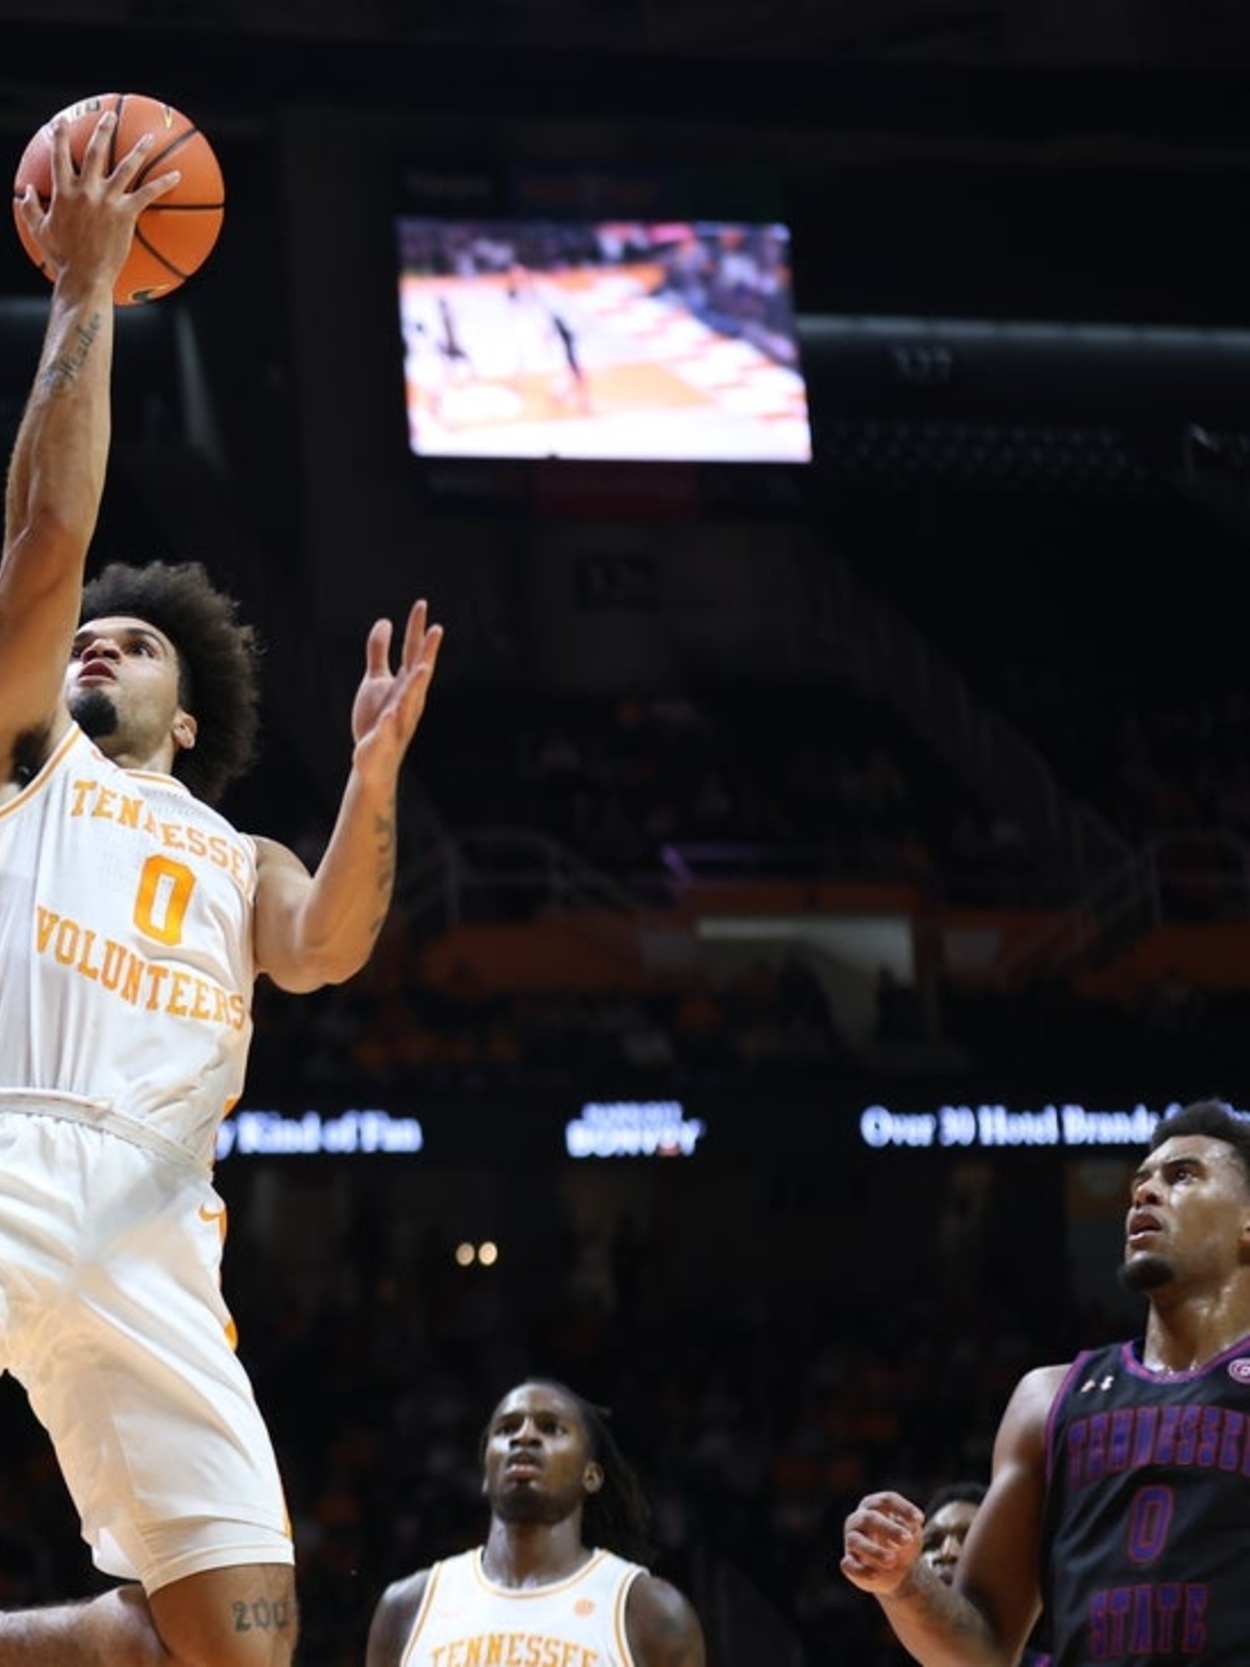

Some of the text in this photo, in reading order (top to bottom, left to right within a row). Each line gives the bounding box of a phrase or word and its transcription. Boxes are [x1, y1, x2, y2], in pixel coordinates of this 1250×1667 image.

[133, 853, 197, 946] 0
[35, 905, 246, 1031] VOLUNTEERS
[238, 1111, 320, 1152] Kind
[322, 1110, 357, 1152] of
[861, 1106, 934, 1147] Over
[941, 1107, 976, 1146] 30
[979, 1105, 1058, 1145] Hotel
[1128, 1483, 1175, 1564] 0
[1089, 1580, 1209, 1663] STATE
